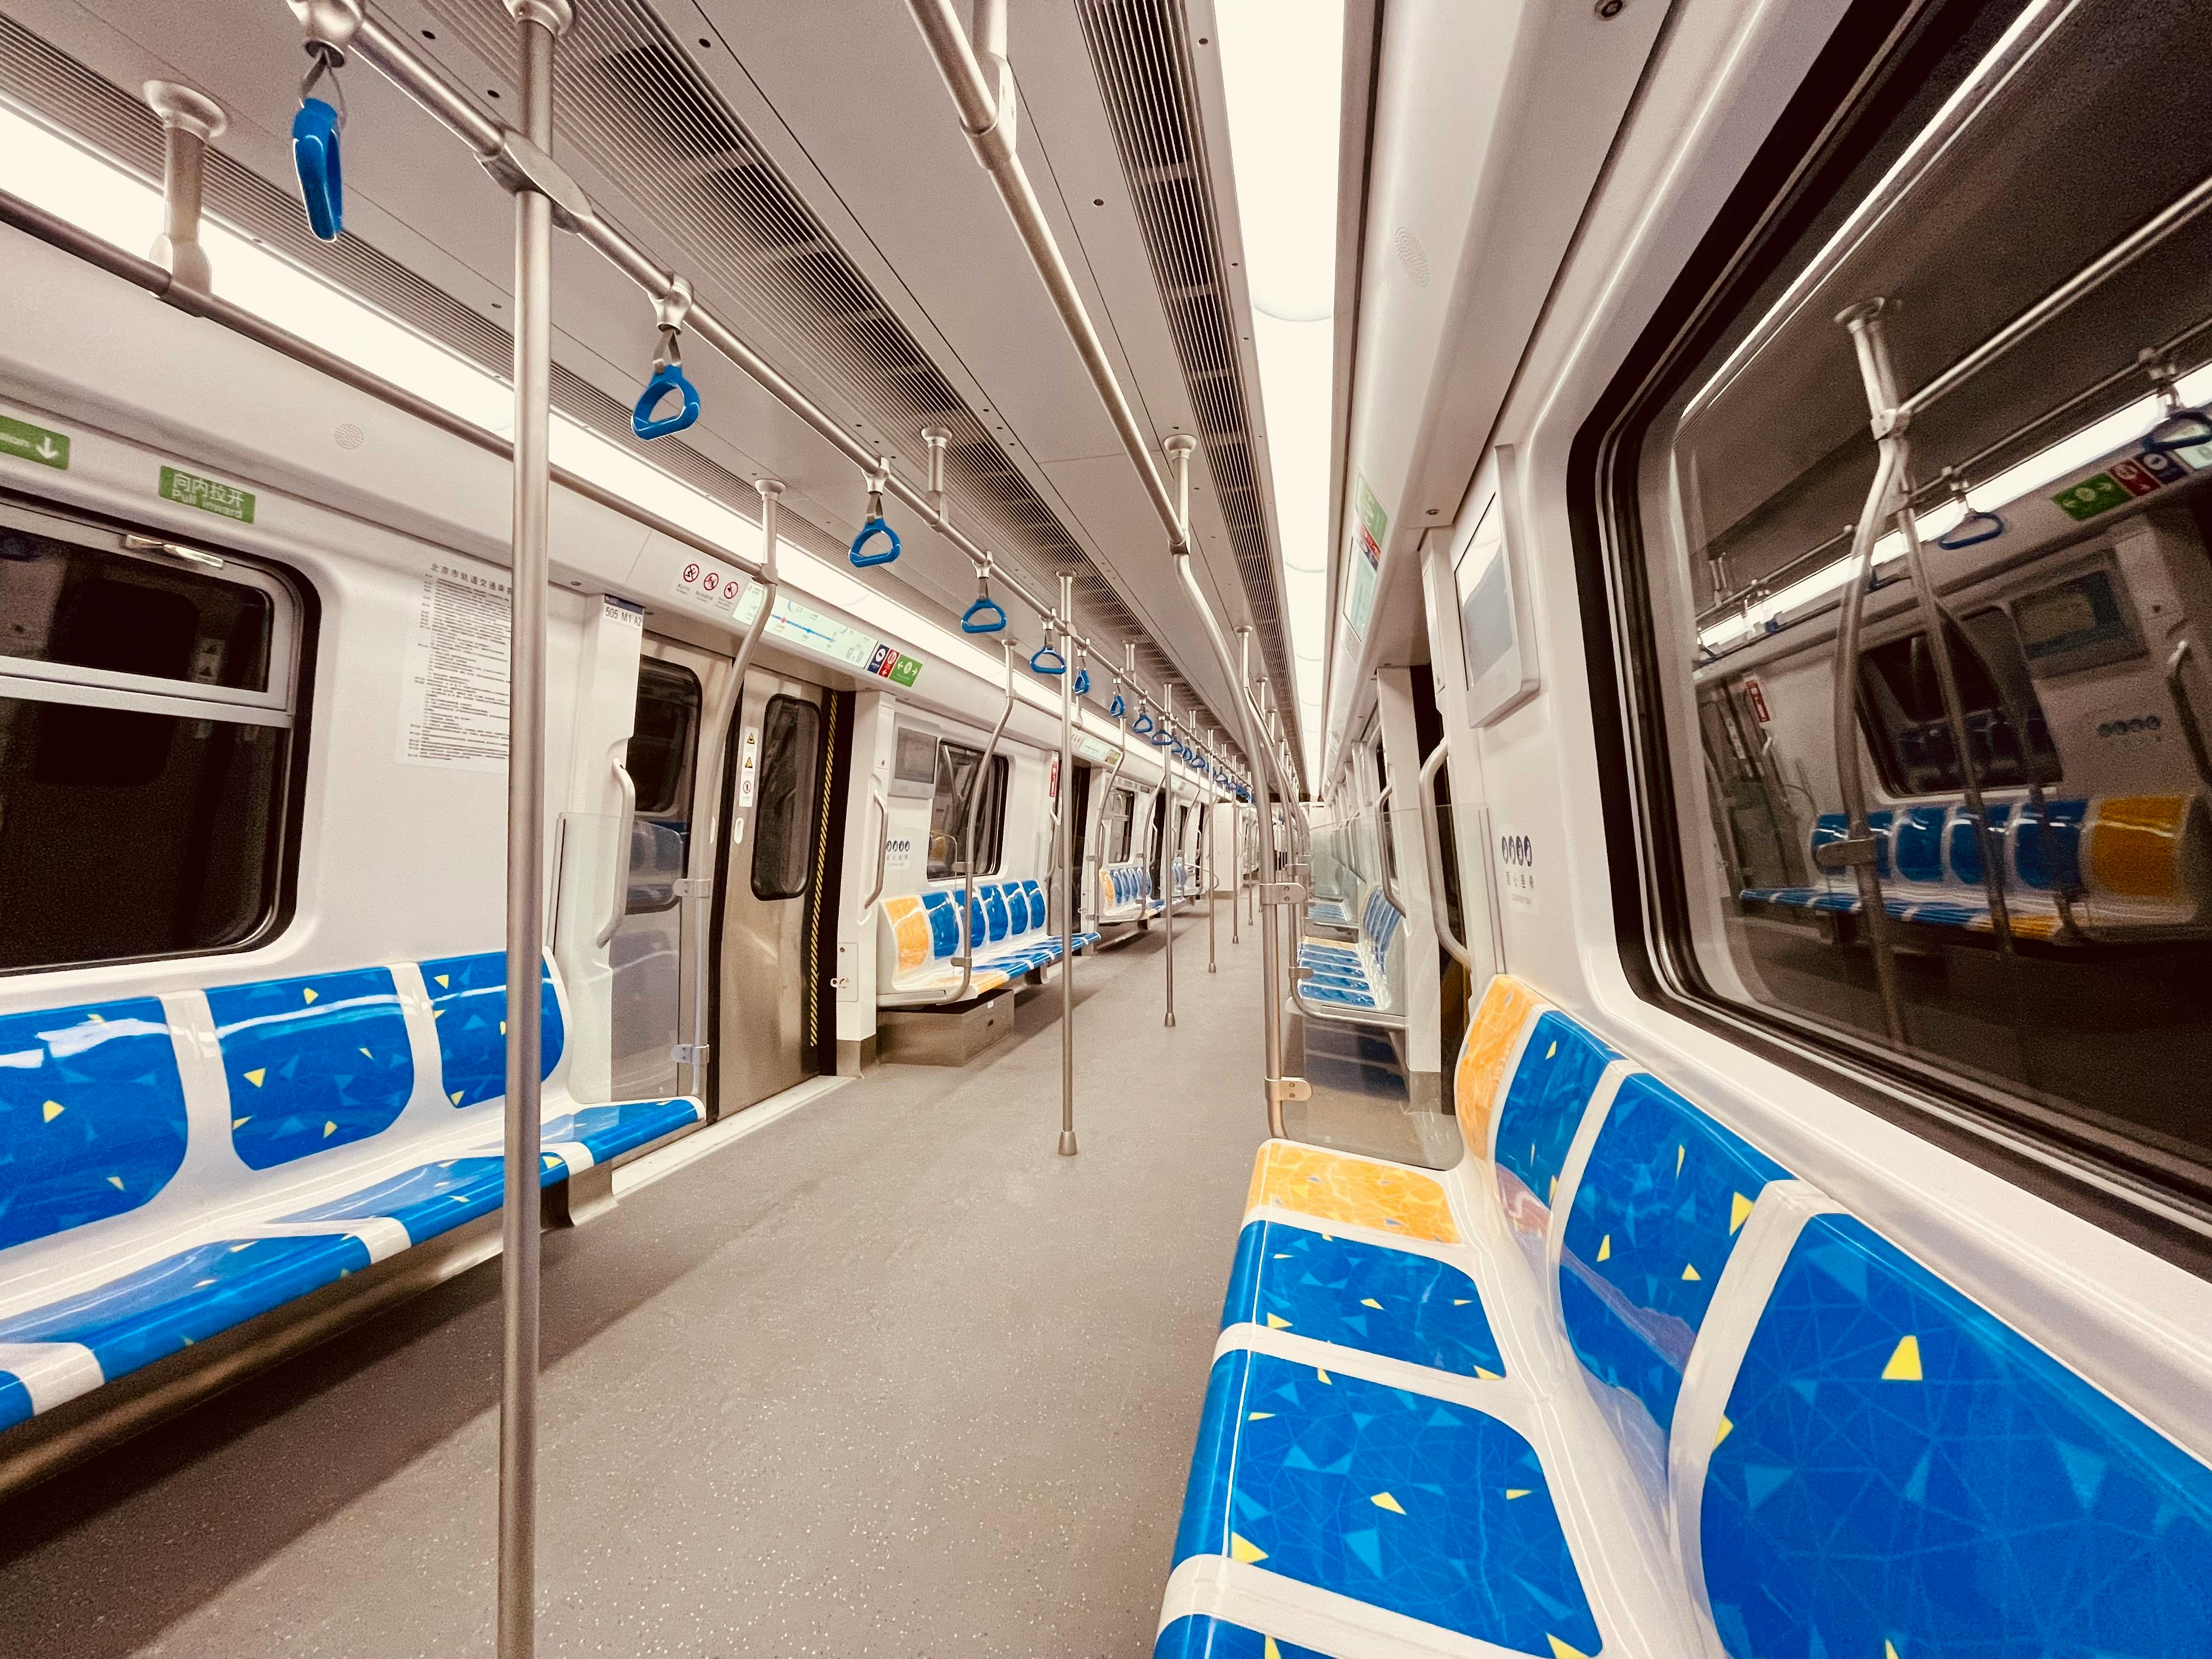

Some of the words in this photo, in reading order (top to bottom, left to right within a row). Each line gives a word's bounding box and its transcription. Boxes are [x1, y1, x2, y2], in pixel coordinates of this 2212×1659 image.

[172, 488, 197, 505] Pull
[173, 473, 245, 508] 向内拉开
[605, 607, 618, 619] 505
[621, 612, 631, 623] M1
[634, 616, 641, 627] A2
